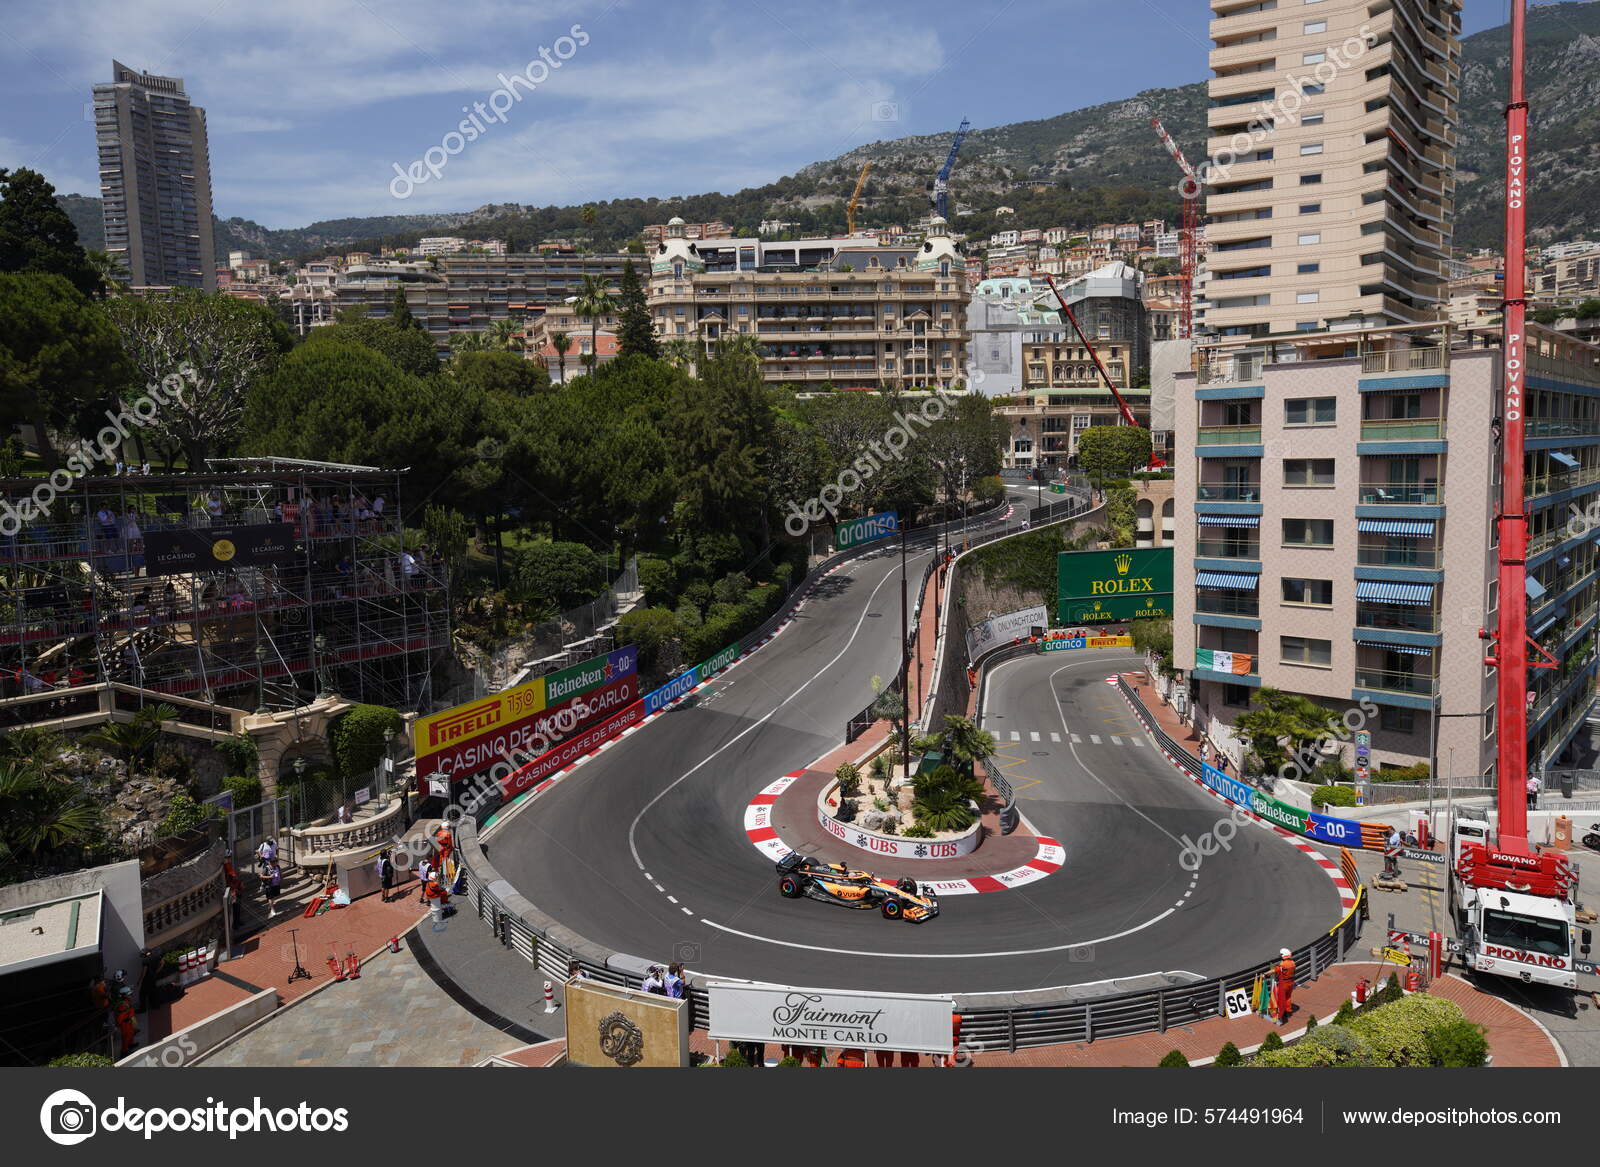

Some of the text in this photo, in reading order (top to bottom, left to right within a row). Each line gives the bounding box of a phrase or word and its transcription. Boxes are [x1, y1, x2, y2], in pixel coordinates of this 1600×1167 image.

[1509, 135, 1522, 208] PIOVANO
[1507, 334, 1520, 420] PIOVANO
[840, 516, 897, 545] aramco
[1091, 578, 1153, 594] ROLEX
[1083, 612, 1112, 620] ROLEX
[1136, 608, 1165, 616] ROLEX
[1046, 640, 1082, 650] aramco
[702, 648, 735, 677] aramco
[549, 668, 601, 700] Heineken
[651, 675, 693, 709] aramco
[429, 700, 502, 747] PIRELLI
[441, 736, 505, 774] CASINO
[510, 725, 531, 748] DE
[516, 711, 636, 787] CASINO CAFE DE PARIS
[1205, 768, 1246, 804] aramco
[1252, 797, 1301, 828] Heineken
[828, 820, 846, 838] UBS
[870, 837, 898, 854] UBS
[930, 843, 958, 858] UBS
[1492, 853, 1536, 866] PIOVANO
[1012, 868, 1035, 879] UBS
[936, 881, 966, 890] UBS
[1486, 946, 1566, 969] PIOVANO
[773, 992, 885, 1030] Fairmont
[1227, 994, 1247, 1014] SC
[773, 1026, 888, 1044] MONTE CARLO
